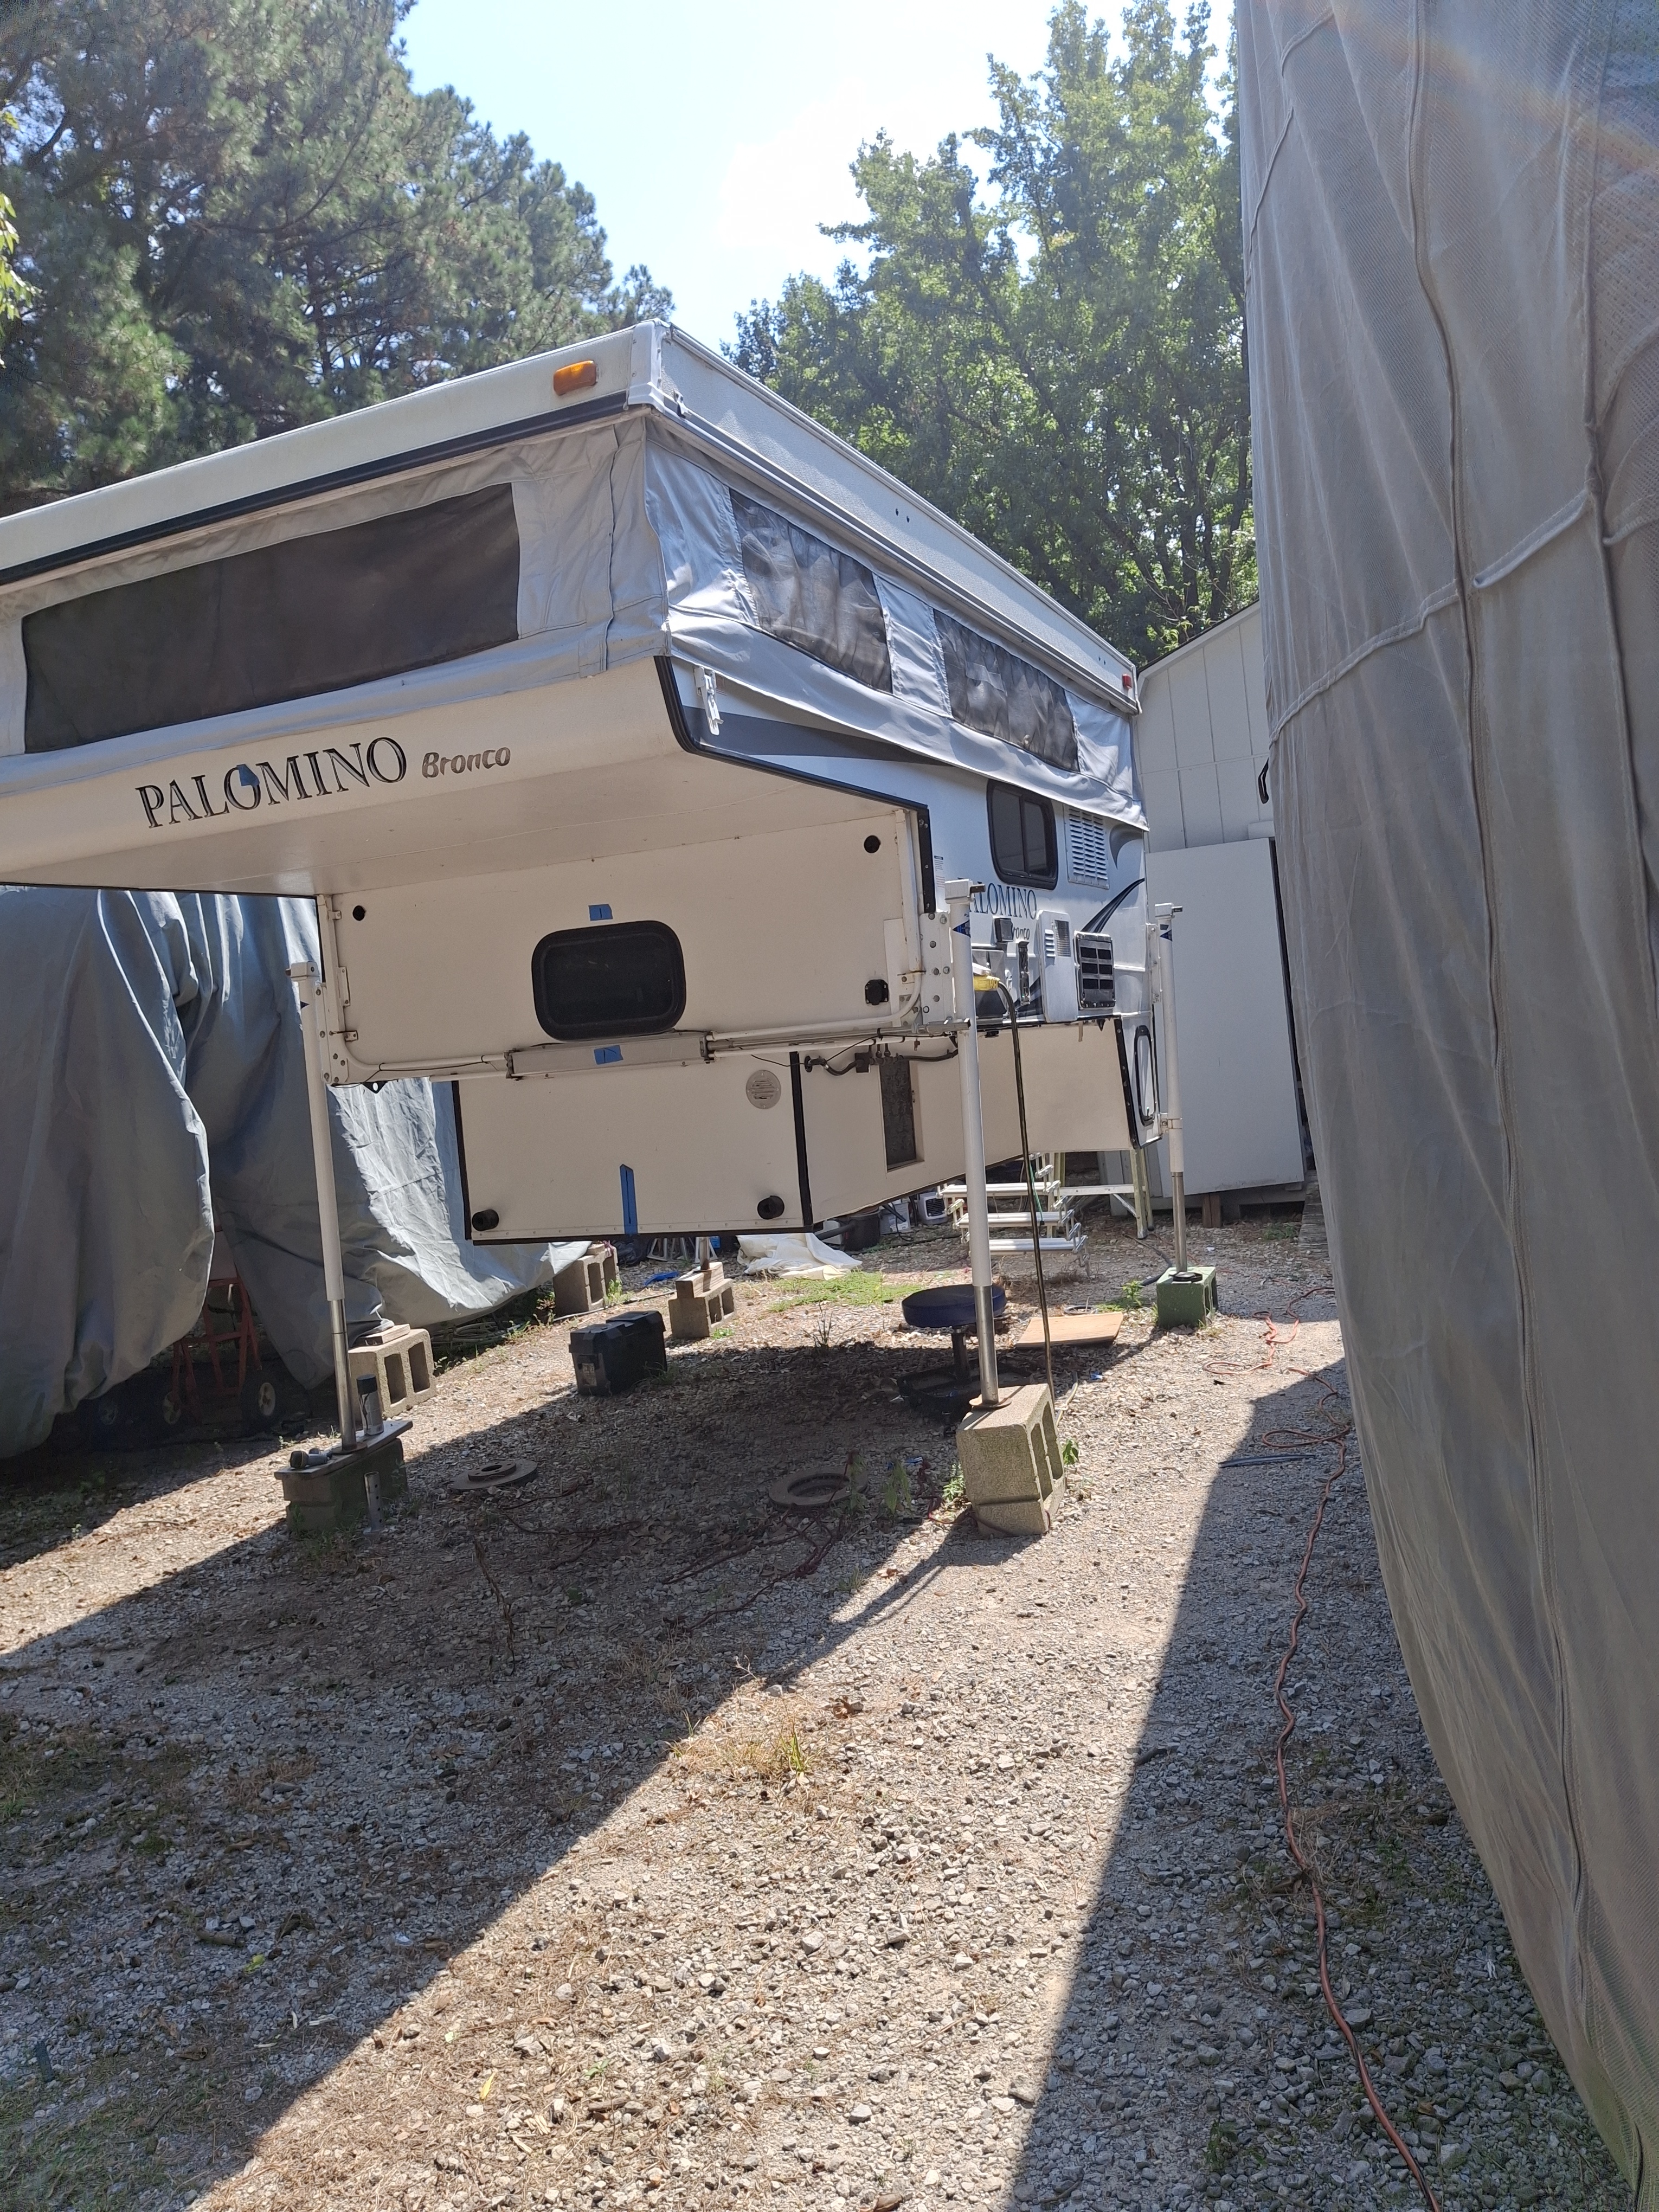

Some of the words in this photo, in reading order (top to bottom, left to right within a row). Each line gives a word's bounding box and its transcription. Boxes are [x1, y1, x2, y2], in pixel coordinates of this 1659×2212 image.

[134, 736, 407, 828] PALOMINO
[421, 747, 511, 779] Bronco
[959, 878, 1037, 920] LOMINO
[1012, 926, 1030, 941] ronco
